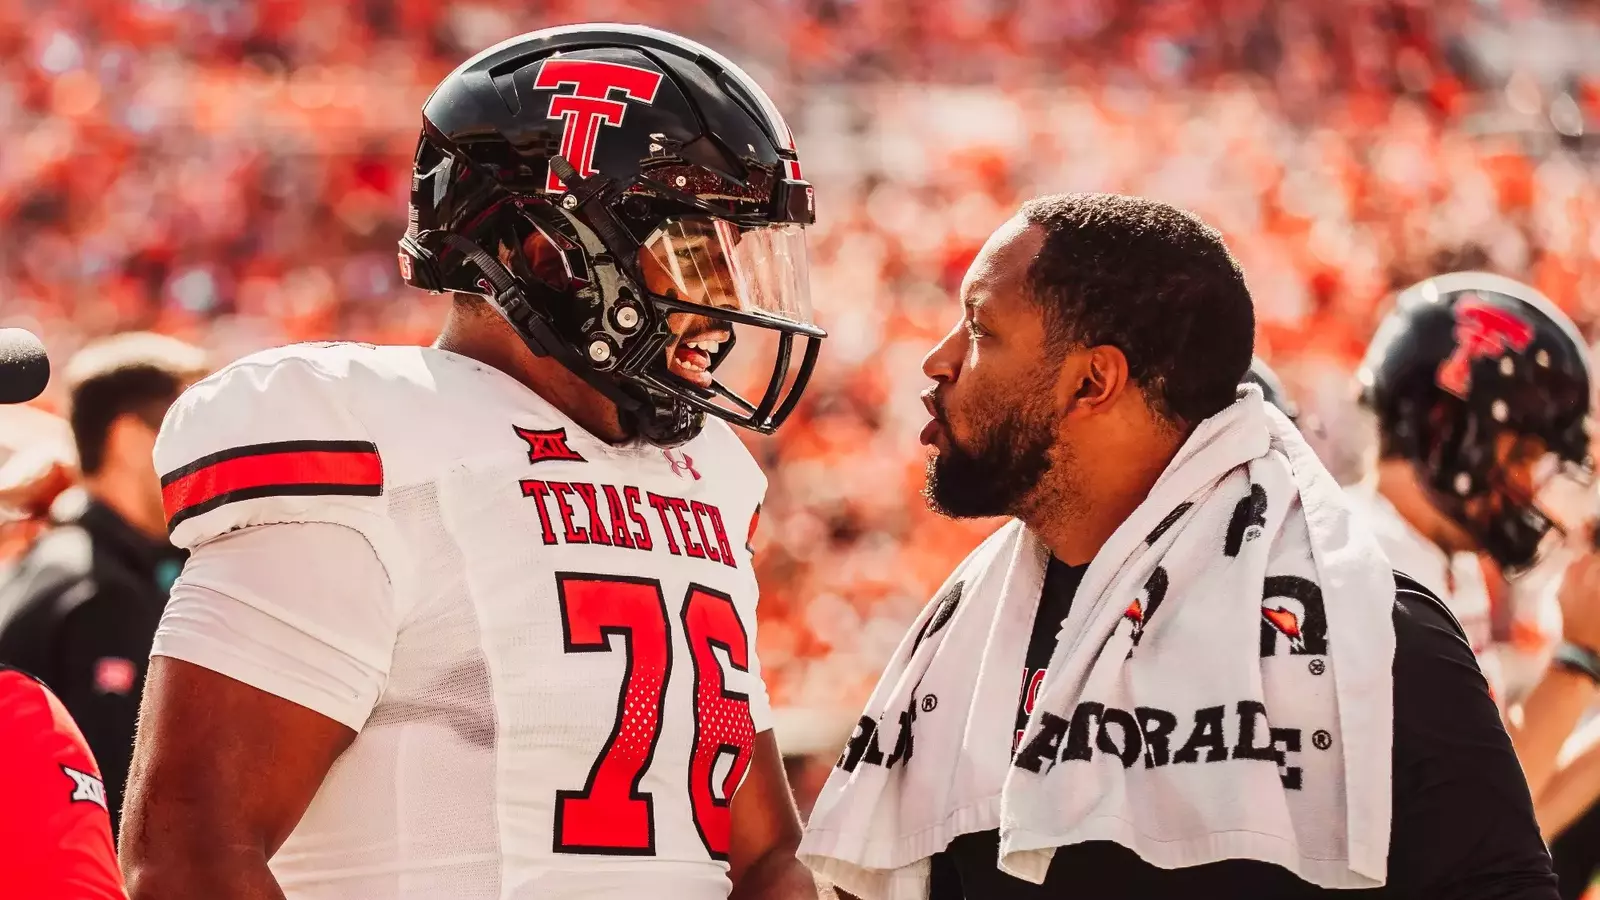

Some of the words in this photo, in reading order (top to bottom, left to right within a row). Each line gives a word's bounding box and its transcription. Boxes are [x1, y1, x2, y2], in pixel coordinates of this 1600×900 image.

[512, 424, 588, 465] XII
[519, 479, 653, 552] TEXAS
[646, 491, 738, 568] TECH
[553, 571, 756, 861] 76
